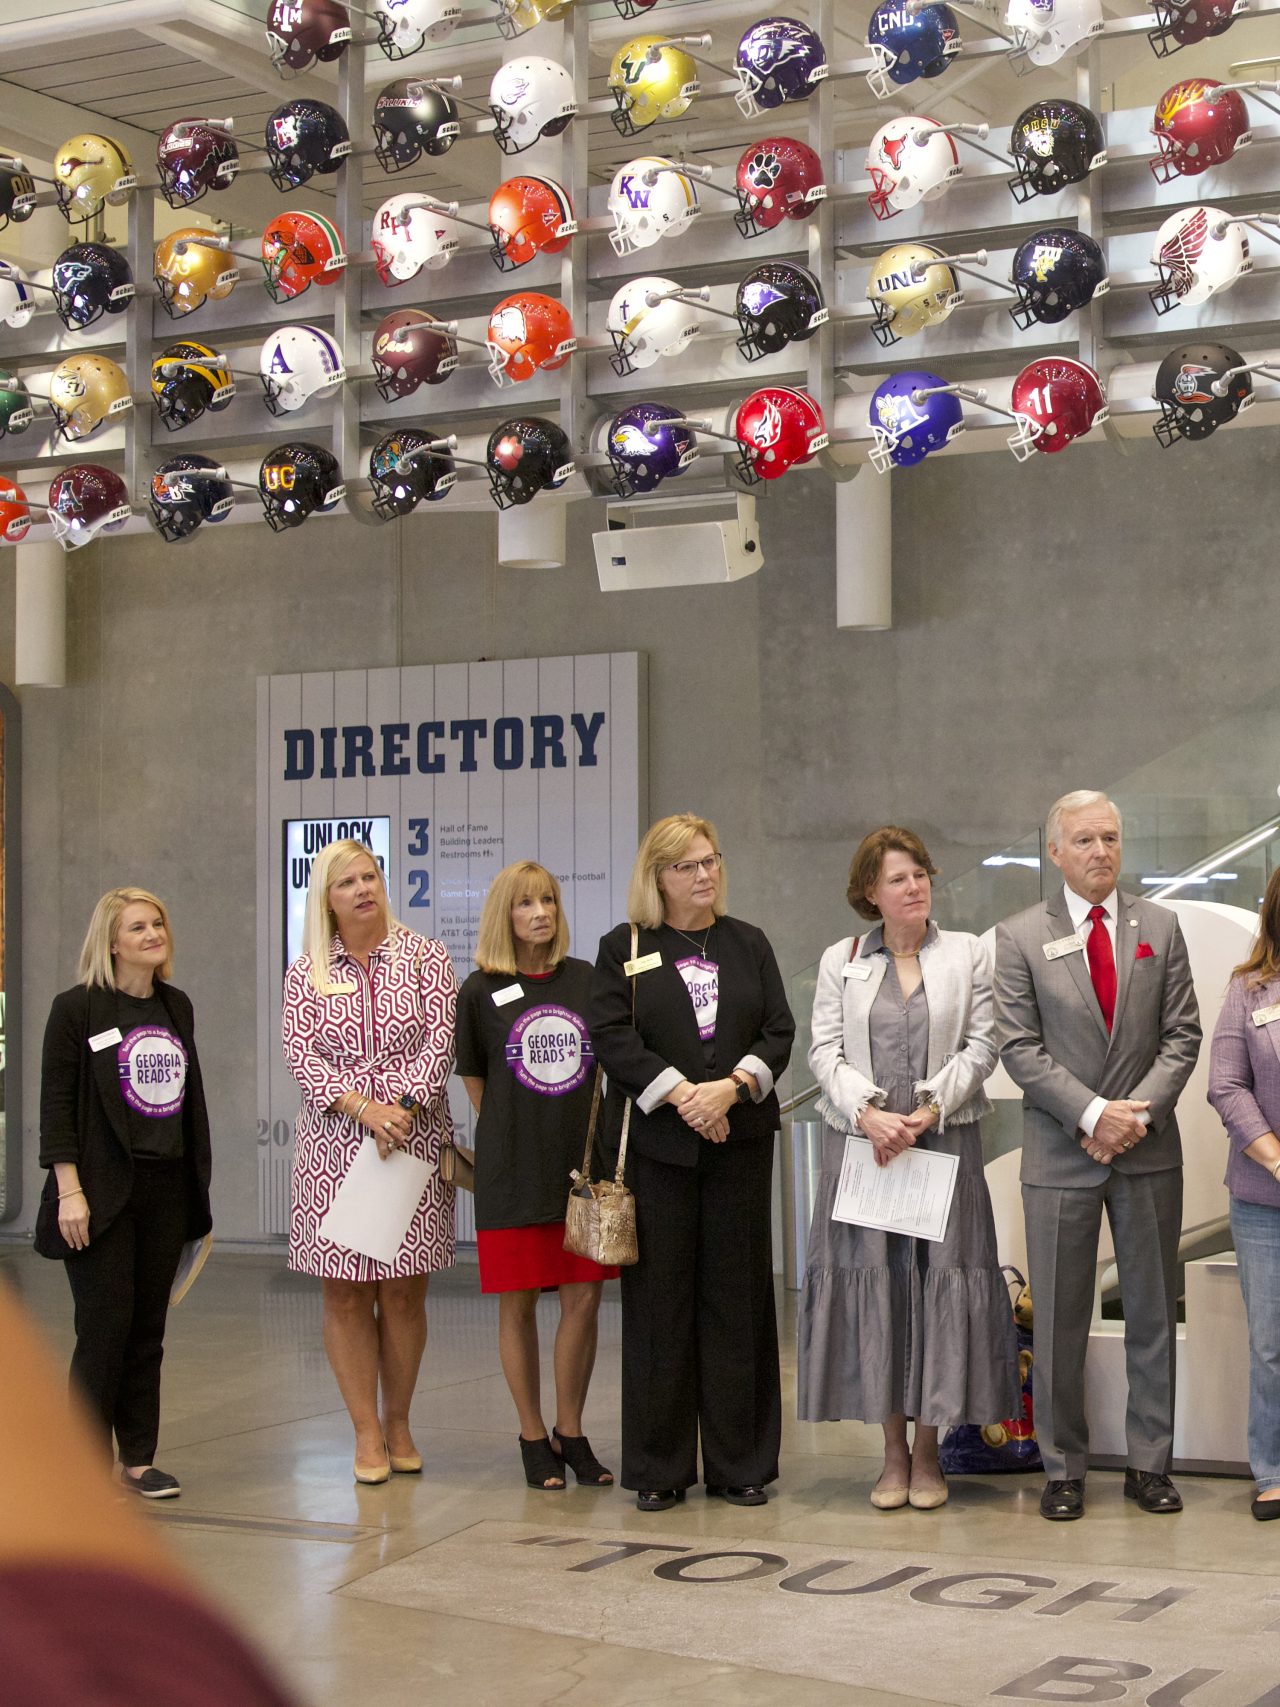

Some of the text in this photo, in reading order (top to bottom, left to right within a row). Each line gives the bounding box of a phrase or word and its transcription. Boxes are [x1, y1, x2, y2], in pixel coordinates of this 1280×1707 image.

[270, 344, 293, 374] A
[1029, 383, 1053, 415] 11
[265, 465, 296, 490] UC
[284, 712, 605, 780] DIRECTORY
[408, 818, 429, 856] 3
[440, 824, 488, 833] Hall of Fame
[440, 837, 504, 846] Building Leaders
[440, 851, 481, 859] Restrooms
[572, 873, 606, 881] Football
[408, 870, 430, 907] 2
[440, 890, 463, 898] Game
[465, 890, 481, 898] Day
[686, 978, 718, 995] ORGIA
[528, 1032, 577, 1049] GEORGIA
[135, 1053, 181, 1068] GEORGIA
[530, 1048, 565, 1064] READS
[137, 1069, 171, 1084] READS
[256, 1119, 290, 1146] 20
